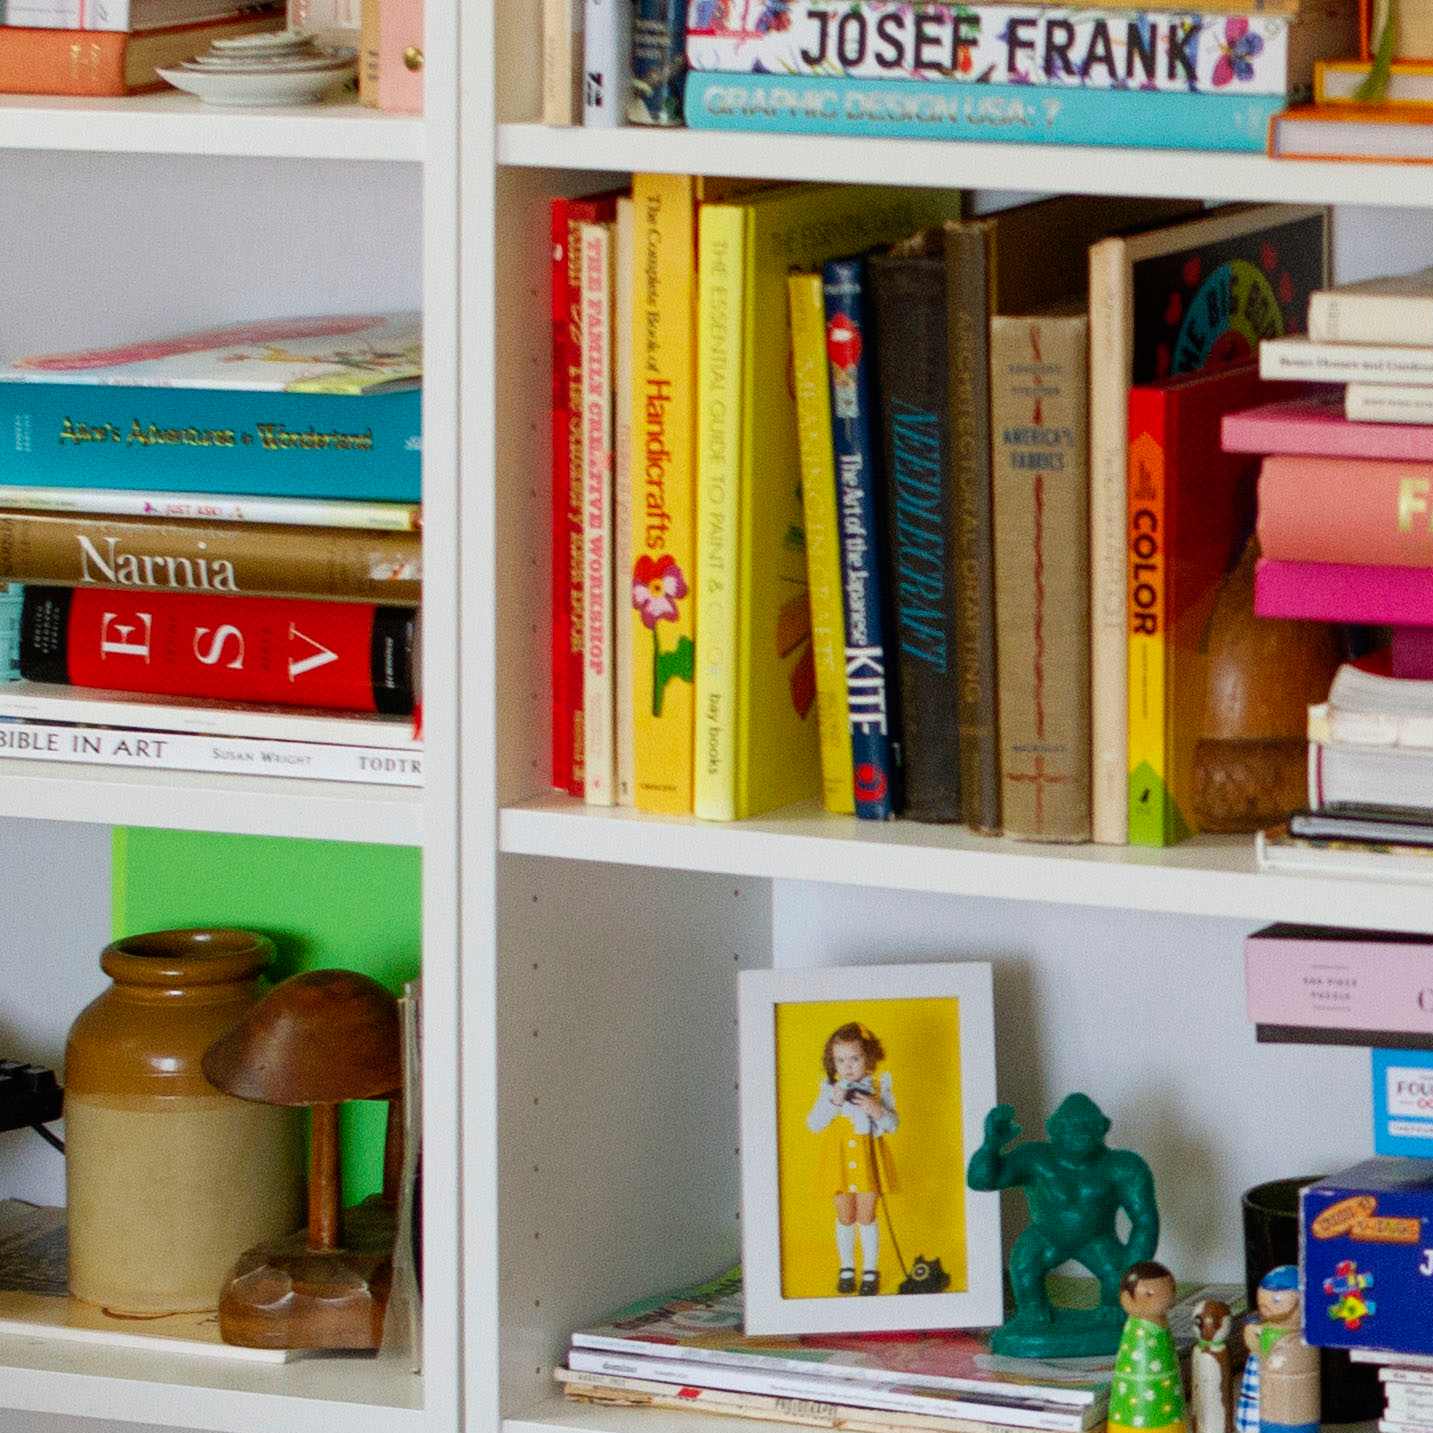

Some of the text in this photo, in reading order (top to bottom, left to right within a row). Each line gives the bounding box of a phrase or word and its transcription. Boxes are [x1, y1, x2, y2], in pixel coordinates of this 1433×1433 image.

[799, 12, 1199, 82] JOSEF FRANK
[60, 416, 373, 452] Alice's Adventures Wonderland
[77, 534, 239, 592] Narnia
[892, 397, 948, 674] NEEDLECRAFT
[1132, 509, 1158, 636] COLOR
[841, 453, 888, 736] The Art of the Japanese KITE
[73, 733, 100, 754] IN
[113, 739, 168, 759] ART
[703, 693, 723, 776] bay books
